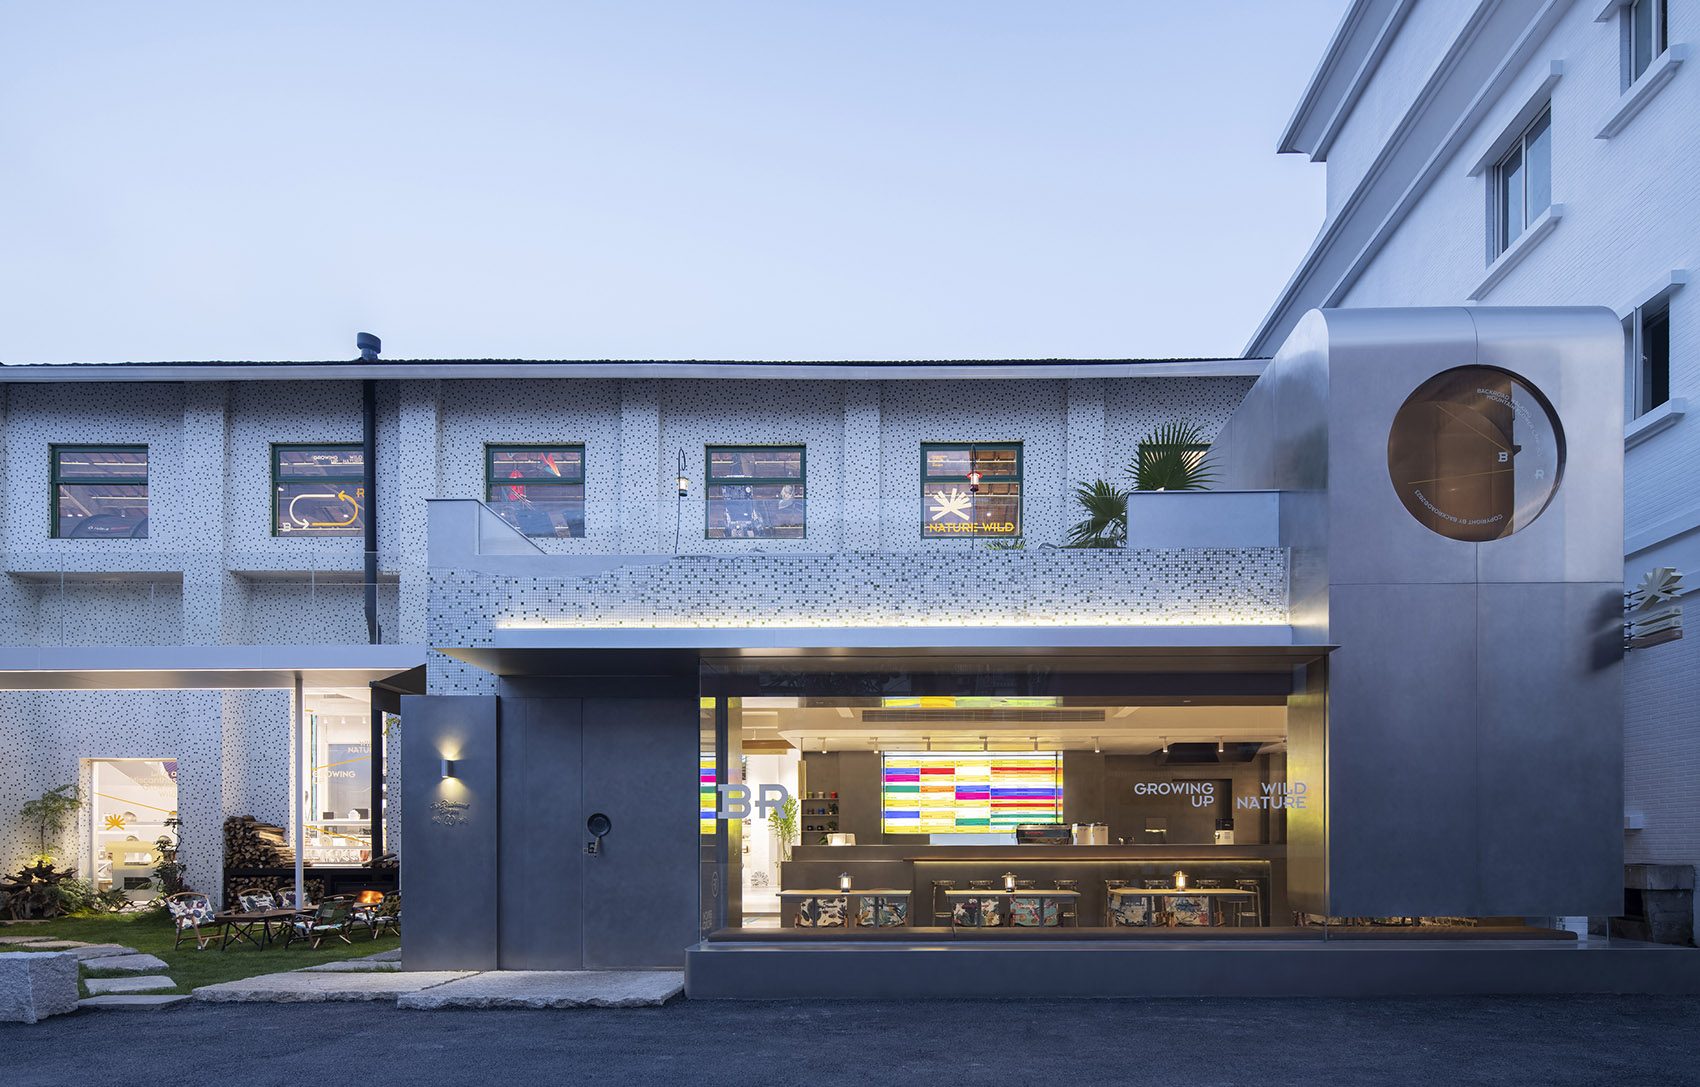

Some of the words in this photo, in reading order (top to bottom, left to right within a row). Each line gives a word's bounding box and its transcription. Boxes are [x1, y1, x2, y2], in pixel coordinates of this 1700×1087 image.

[1477, 388, 1510, 400] BACKROAD
[1498, 452, 1508, 462] B
[929, 523, 978, 533] NATURE
[982, 522, 1015, 533] WILD
[347, 746, 371, 754] NATU
[1134, 782, 1215, 795] GROWING
[1261, 782, 1307, 795] WILD
[717, 784, 789, 819] BR
[1191, 795, 1215, 808] UP
[1237, 796, 1307, 809] NATURE
